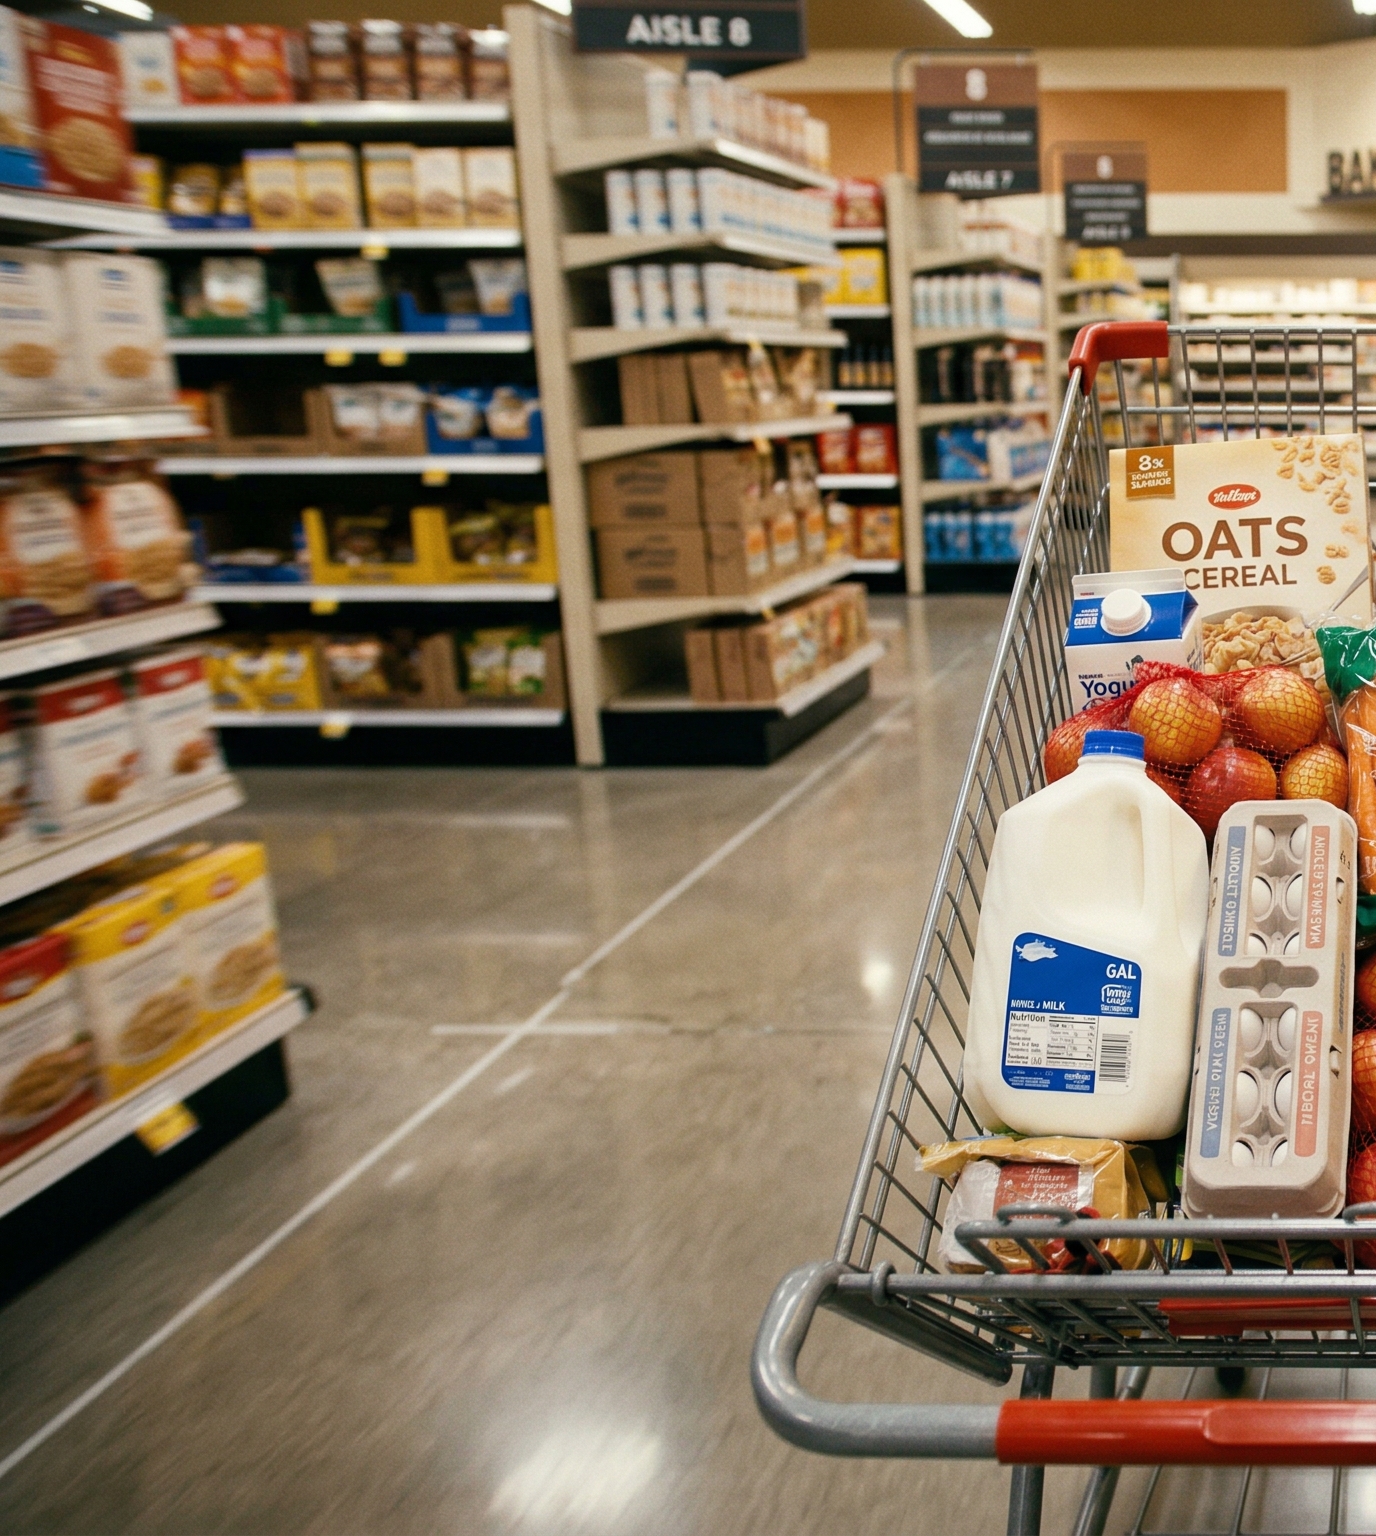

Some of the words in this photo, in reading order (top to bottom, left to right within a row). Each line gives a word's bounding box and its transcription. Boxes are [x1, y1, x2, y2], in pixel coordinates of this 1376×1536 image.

[626, 14, 723, 46] AISLE
[728, 17, 751, 47] 8
[945, 170, 998, 190] AISLE
[1161, 515, 1308, 562] OATS
[1184, 563, 1297, 591] CEREAL
[1106, 963, 1137, 980] GAL
[1042, 1000, 1066, 1011] MILK
